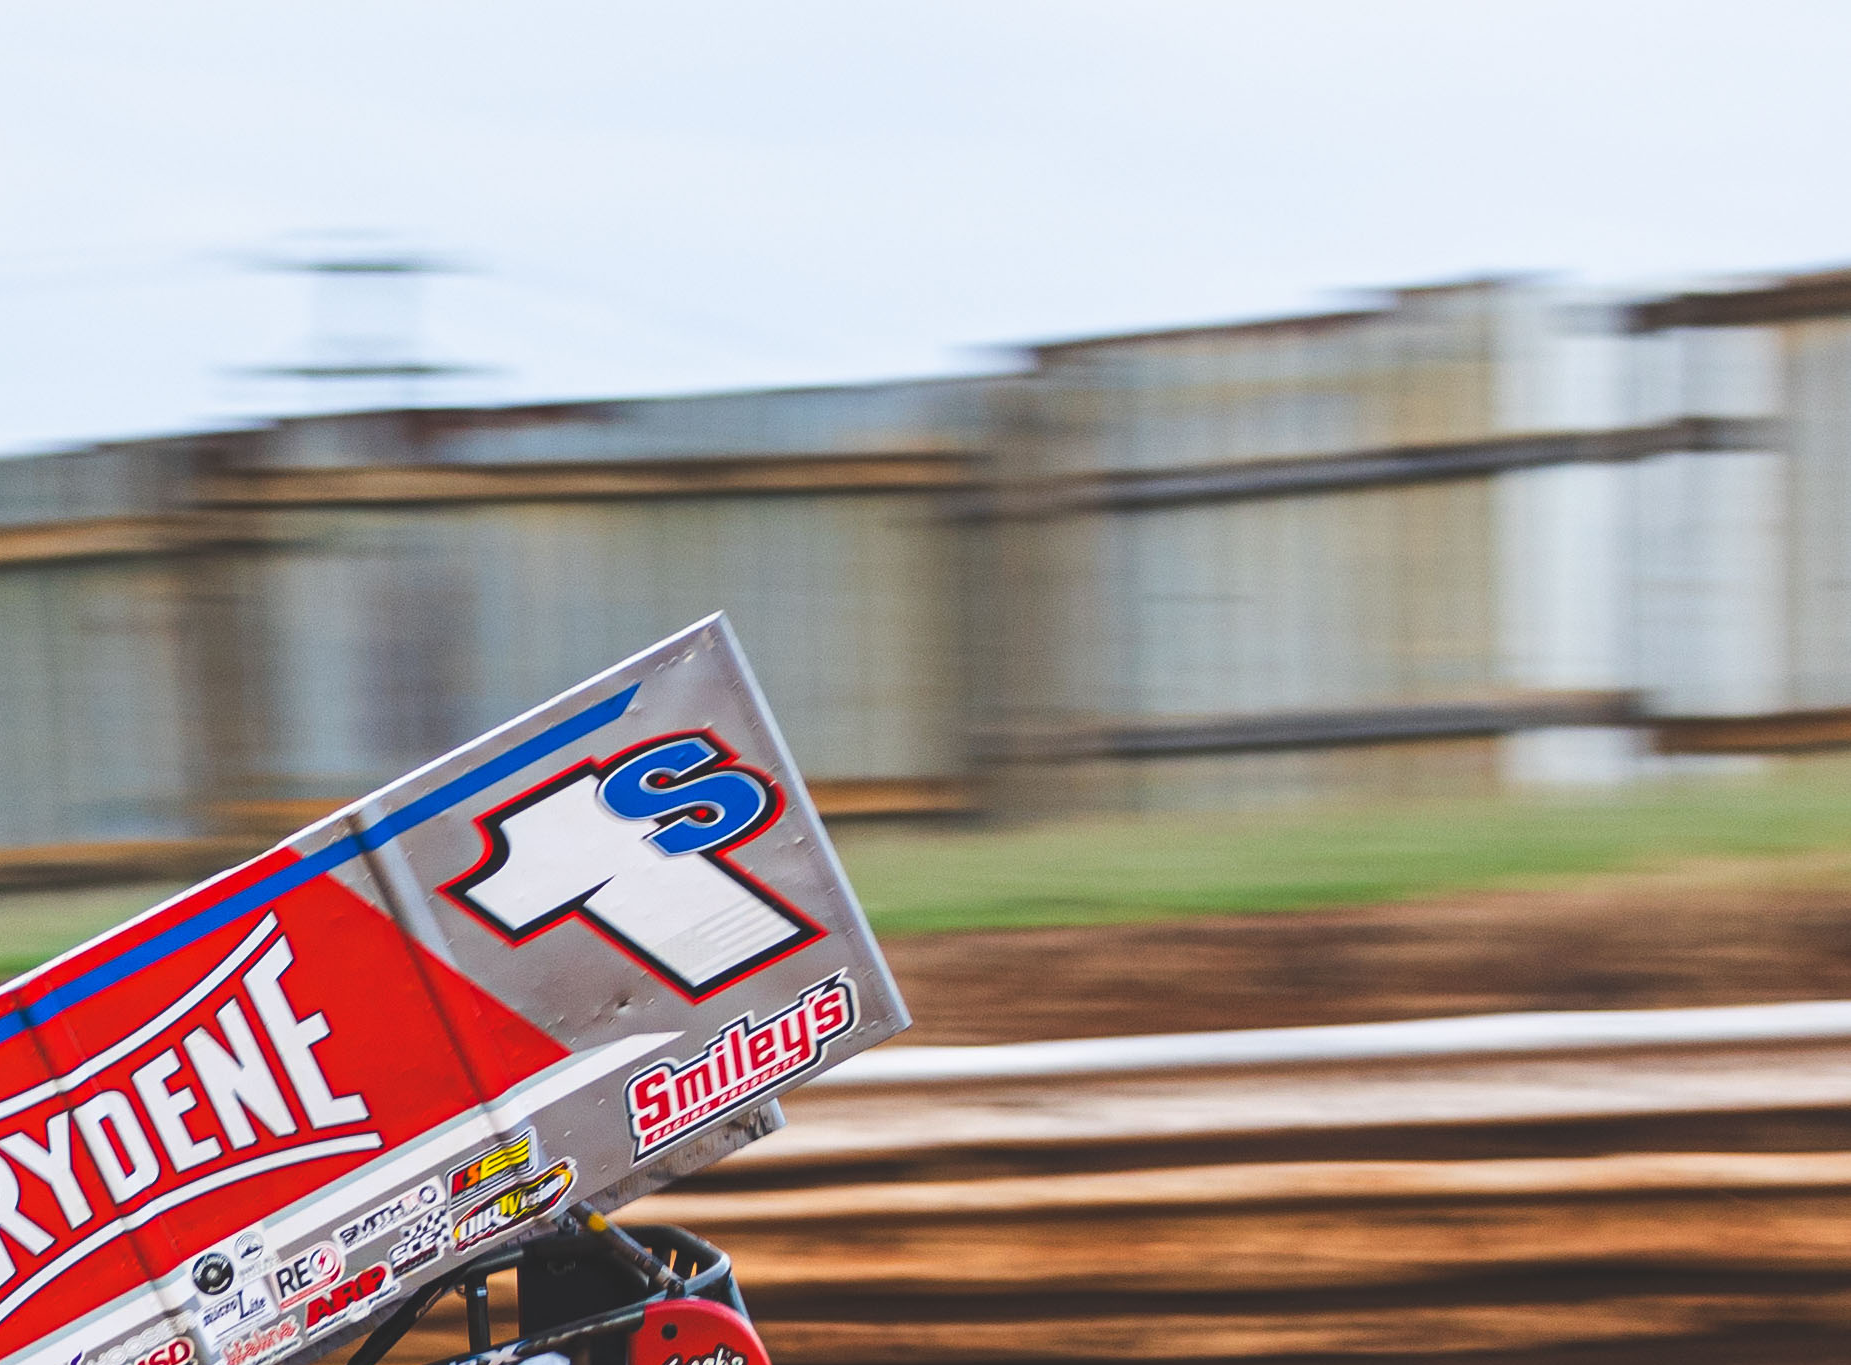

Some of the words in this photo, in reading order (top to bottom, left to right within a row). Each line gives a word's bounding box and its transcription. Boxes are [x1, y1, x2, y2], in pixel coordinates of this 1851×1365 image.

[634, 990, 844, 1132] Smiley's
[651, 1101, 713, 1143] RACING
[718, 1053, 803, 1106] PRODUCTS
[306, 1265, 386, 1328] ARP
